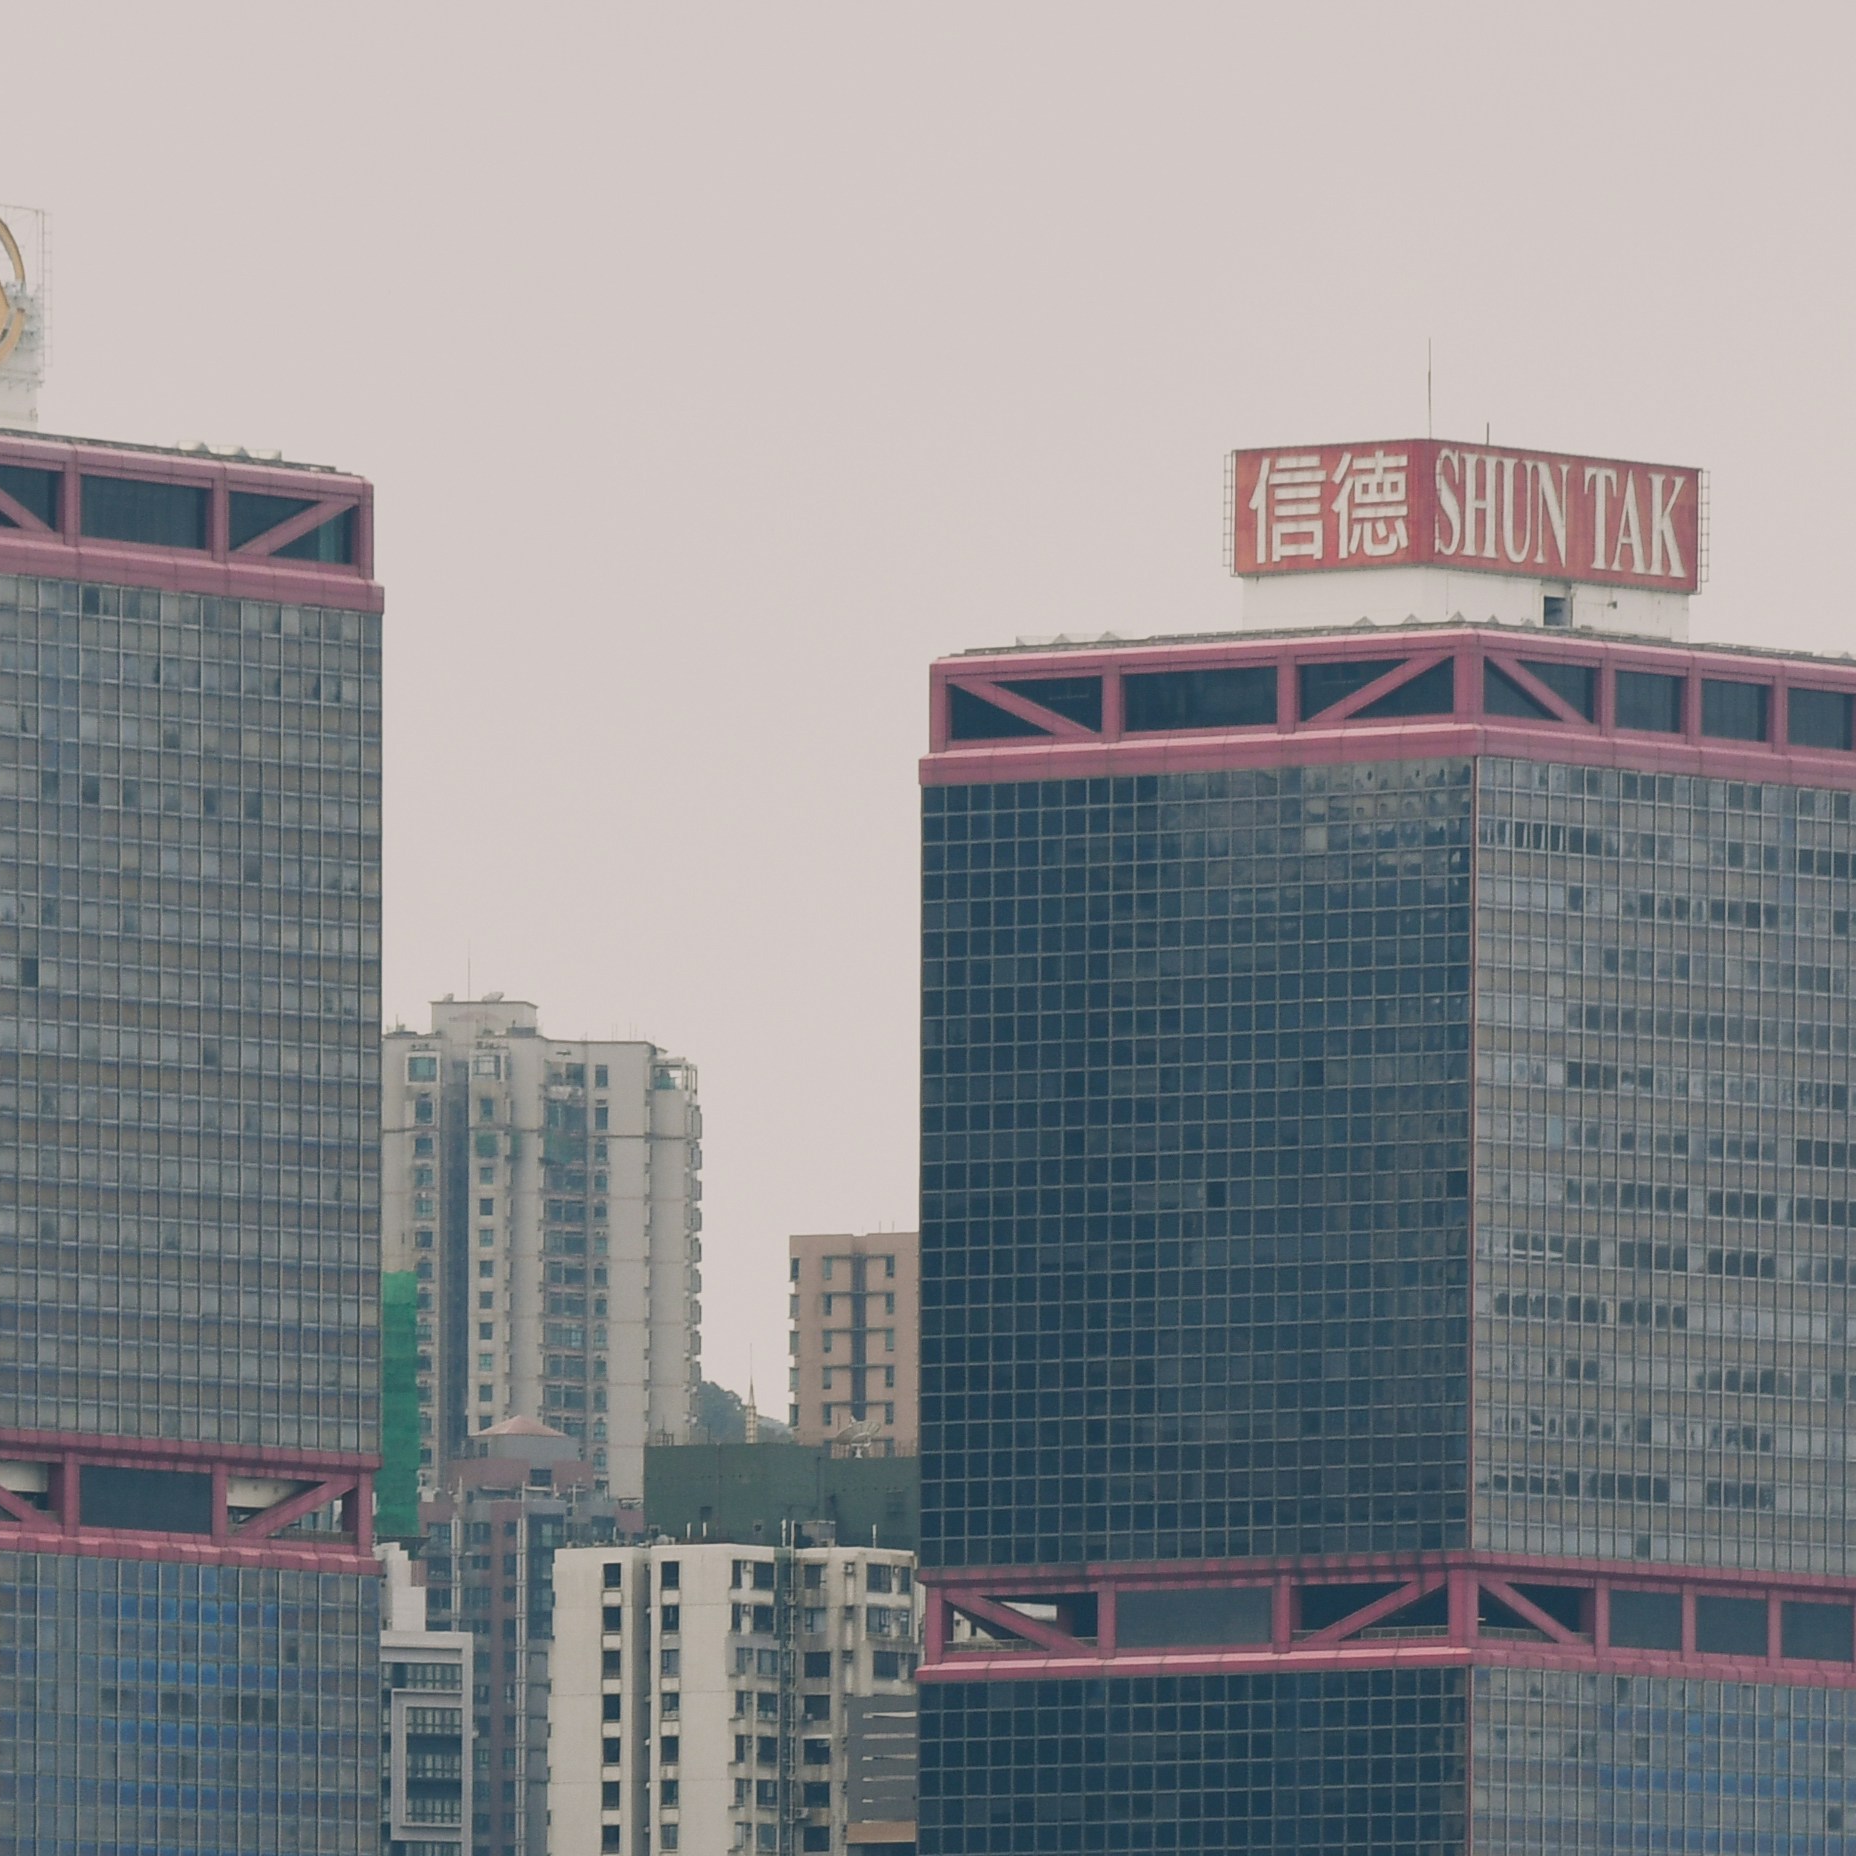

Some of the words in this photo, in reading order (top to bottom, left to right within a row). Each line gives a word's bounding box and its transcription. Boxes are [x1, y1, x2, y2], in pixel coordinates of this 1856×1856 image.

[1248, 449, 1410, 564] 信德
[1434, 447, 1570, 569] SHUN
[1583, 464, 1688, 580] TAK
